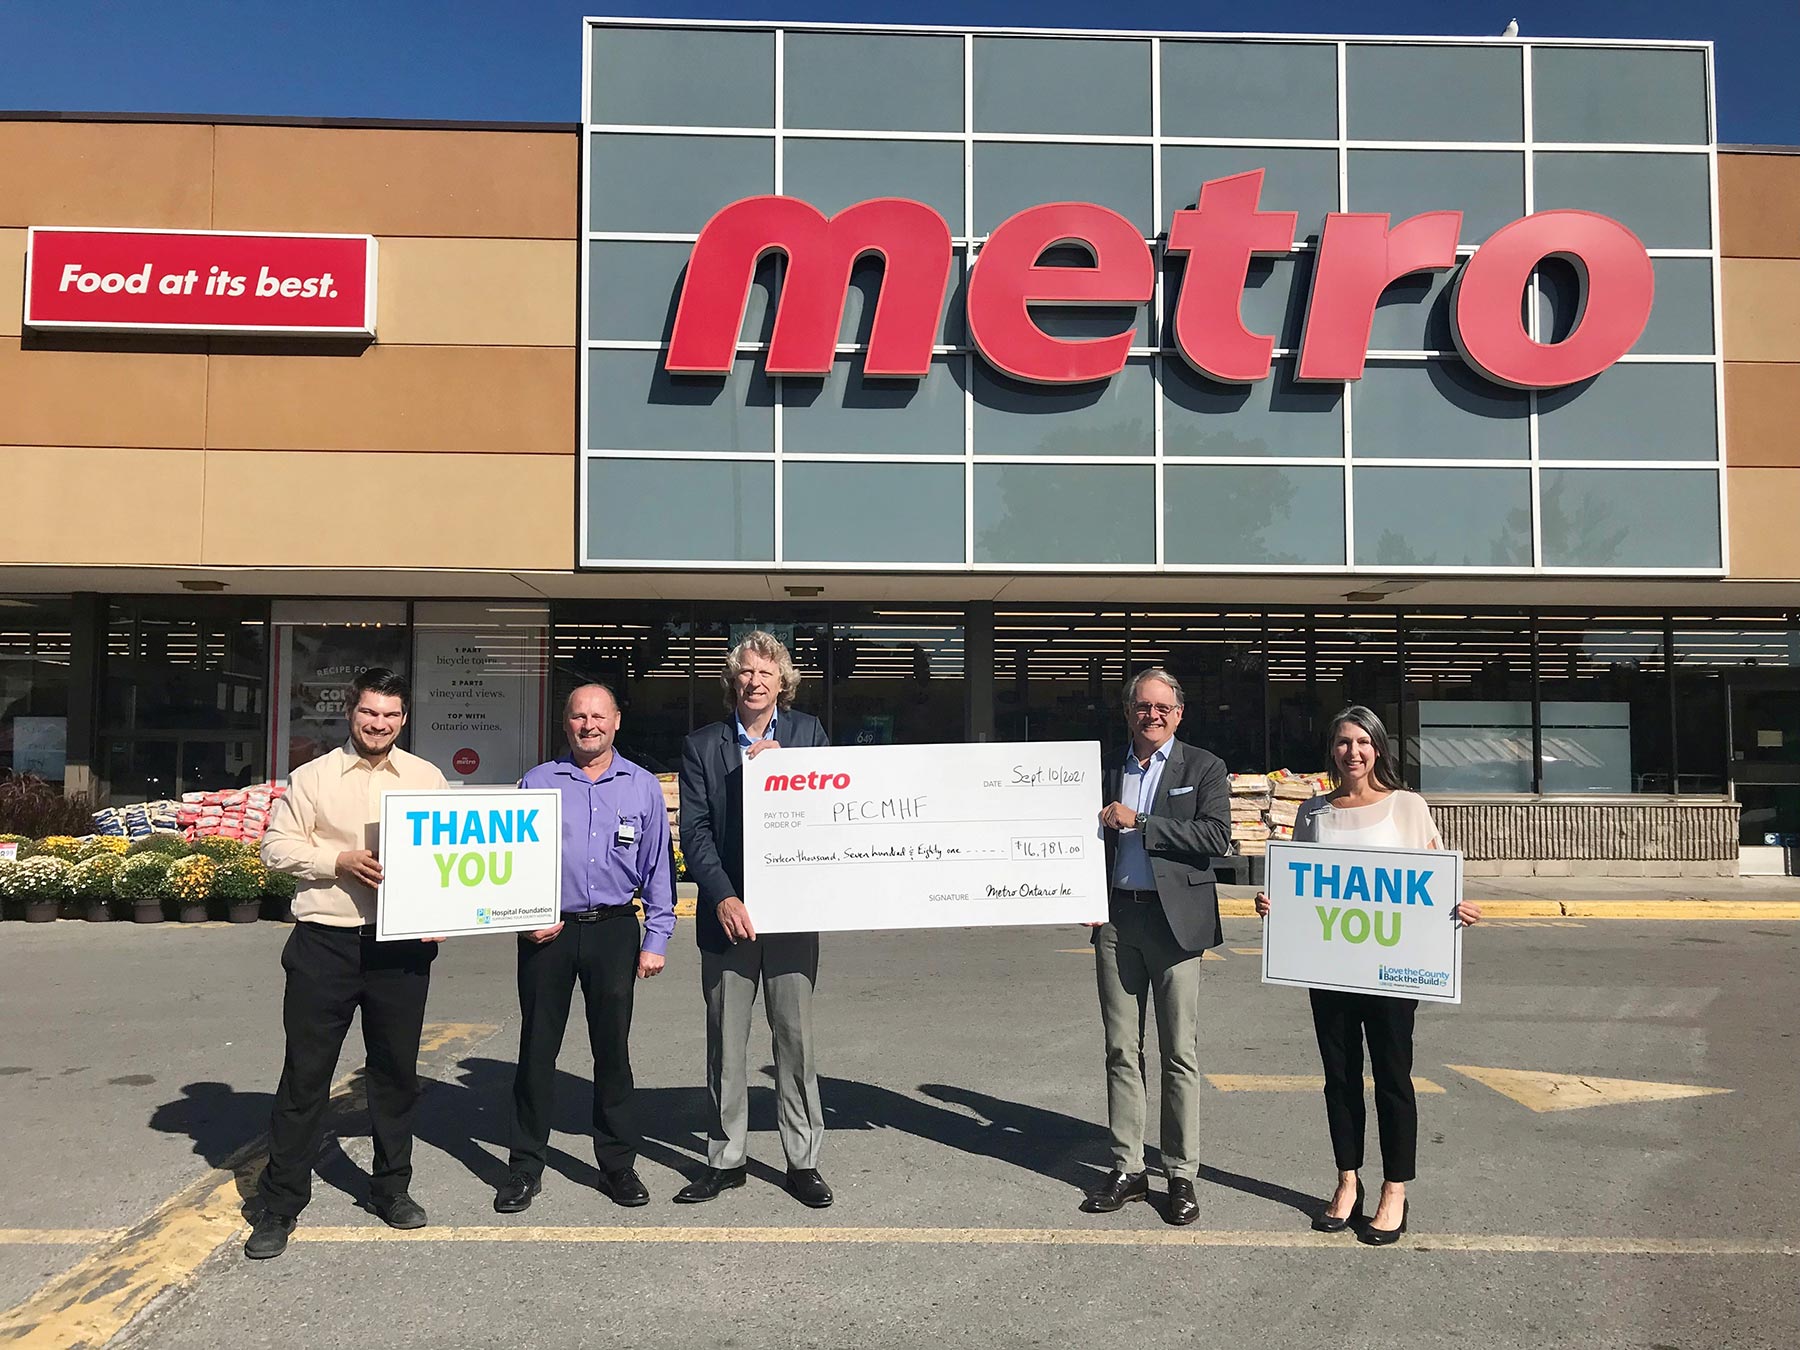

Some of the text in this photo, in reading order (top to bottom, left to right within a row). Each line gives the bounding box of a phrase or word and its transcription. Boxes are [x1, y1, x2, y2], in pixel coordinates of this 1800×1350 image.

[59, 264, 339, 299] Food at its best.
[665, 167, 1654, 388] metro
[436, 655, 470, 667] bicycle
[316, 665, 369, 677] RECIPE FO
[430, 688, 505, 700] vineyard views.
[431, 721, 502, 731] Ontario wines.
[764, 771, 851, 792] metro
[983, 780, 1002, 788] DATE
[764, 810, 805, 819] PAY TO THE
[833, 795, 927, 823] PECMHF
[406, 809, 540, 846] THANK
[764, 820, 802, 829] ORDER OF
[843, 847, 870, 859] Seven
[917, 843, 942, 860] Eighty
[433, 851, 513, 888] YOU
[985, 883, 1018, 899] Metro
[1019, 883, 1058, 898] Ontario
[1288, 861, 1434, 906] THANK
[928, 893, 969, 902] SIGNATURE
[491, 906, 553, 917] Hospital Foundation
[1315, 905, 1402, 947] YOU
[1384, 965, 1403, 975] Love
[1404, 967, 1418, 976] the
[1418, 968, 1450, 980] County
[1384, 973, 1403, 982] Back
[1404, 975, 1417, 984] the
[1418, 976, 1439, 986] Build
